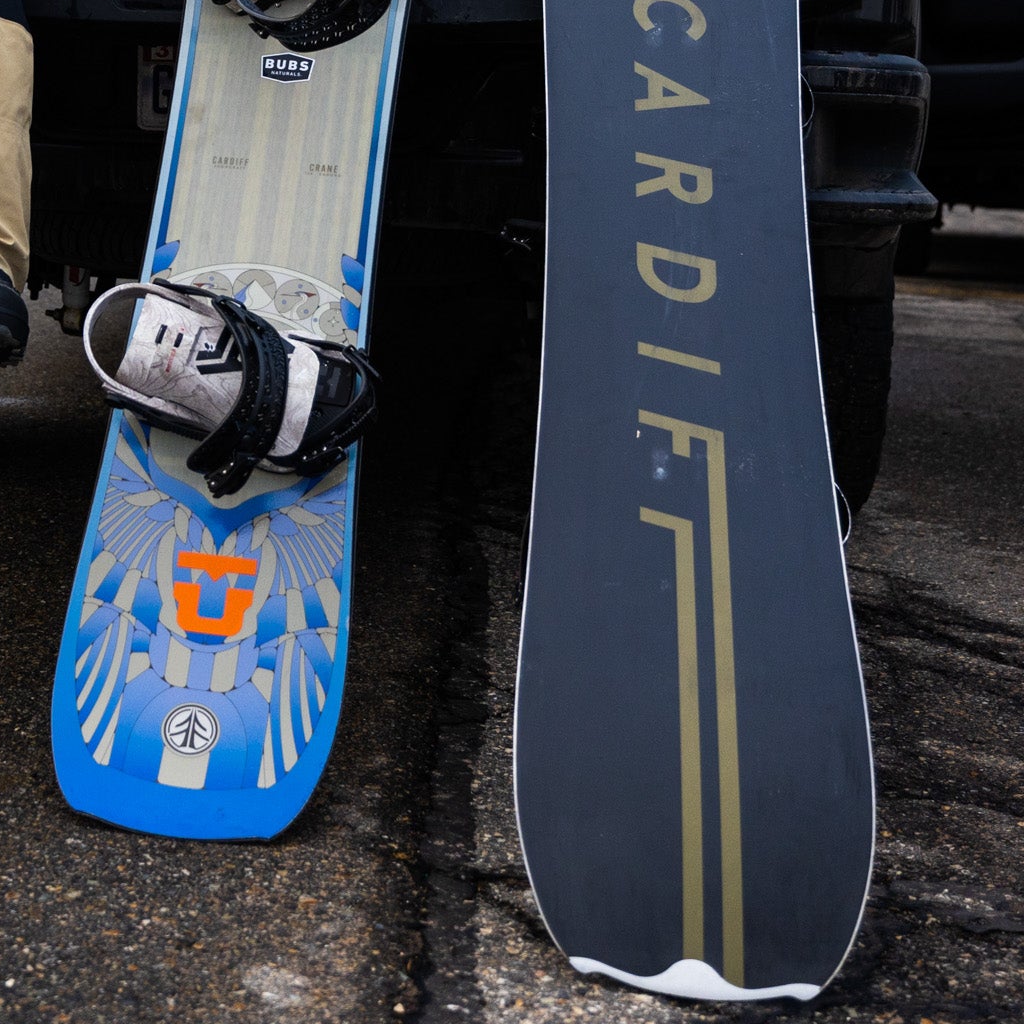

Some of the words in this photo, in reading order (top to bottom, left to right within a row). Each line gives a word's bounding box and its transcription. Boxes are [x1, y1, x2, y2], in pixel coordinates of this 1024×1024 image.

[264, 58, 310, 72] BUBS
[212, 156, 250, 167] CARDIFF
[309, 163, 339, 174] CRANE
